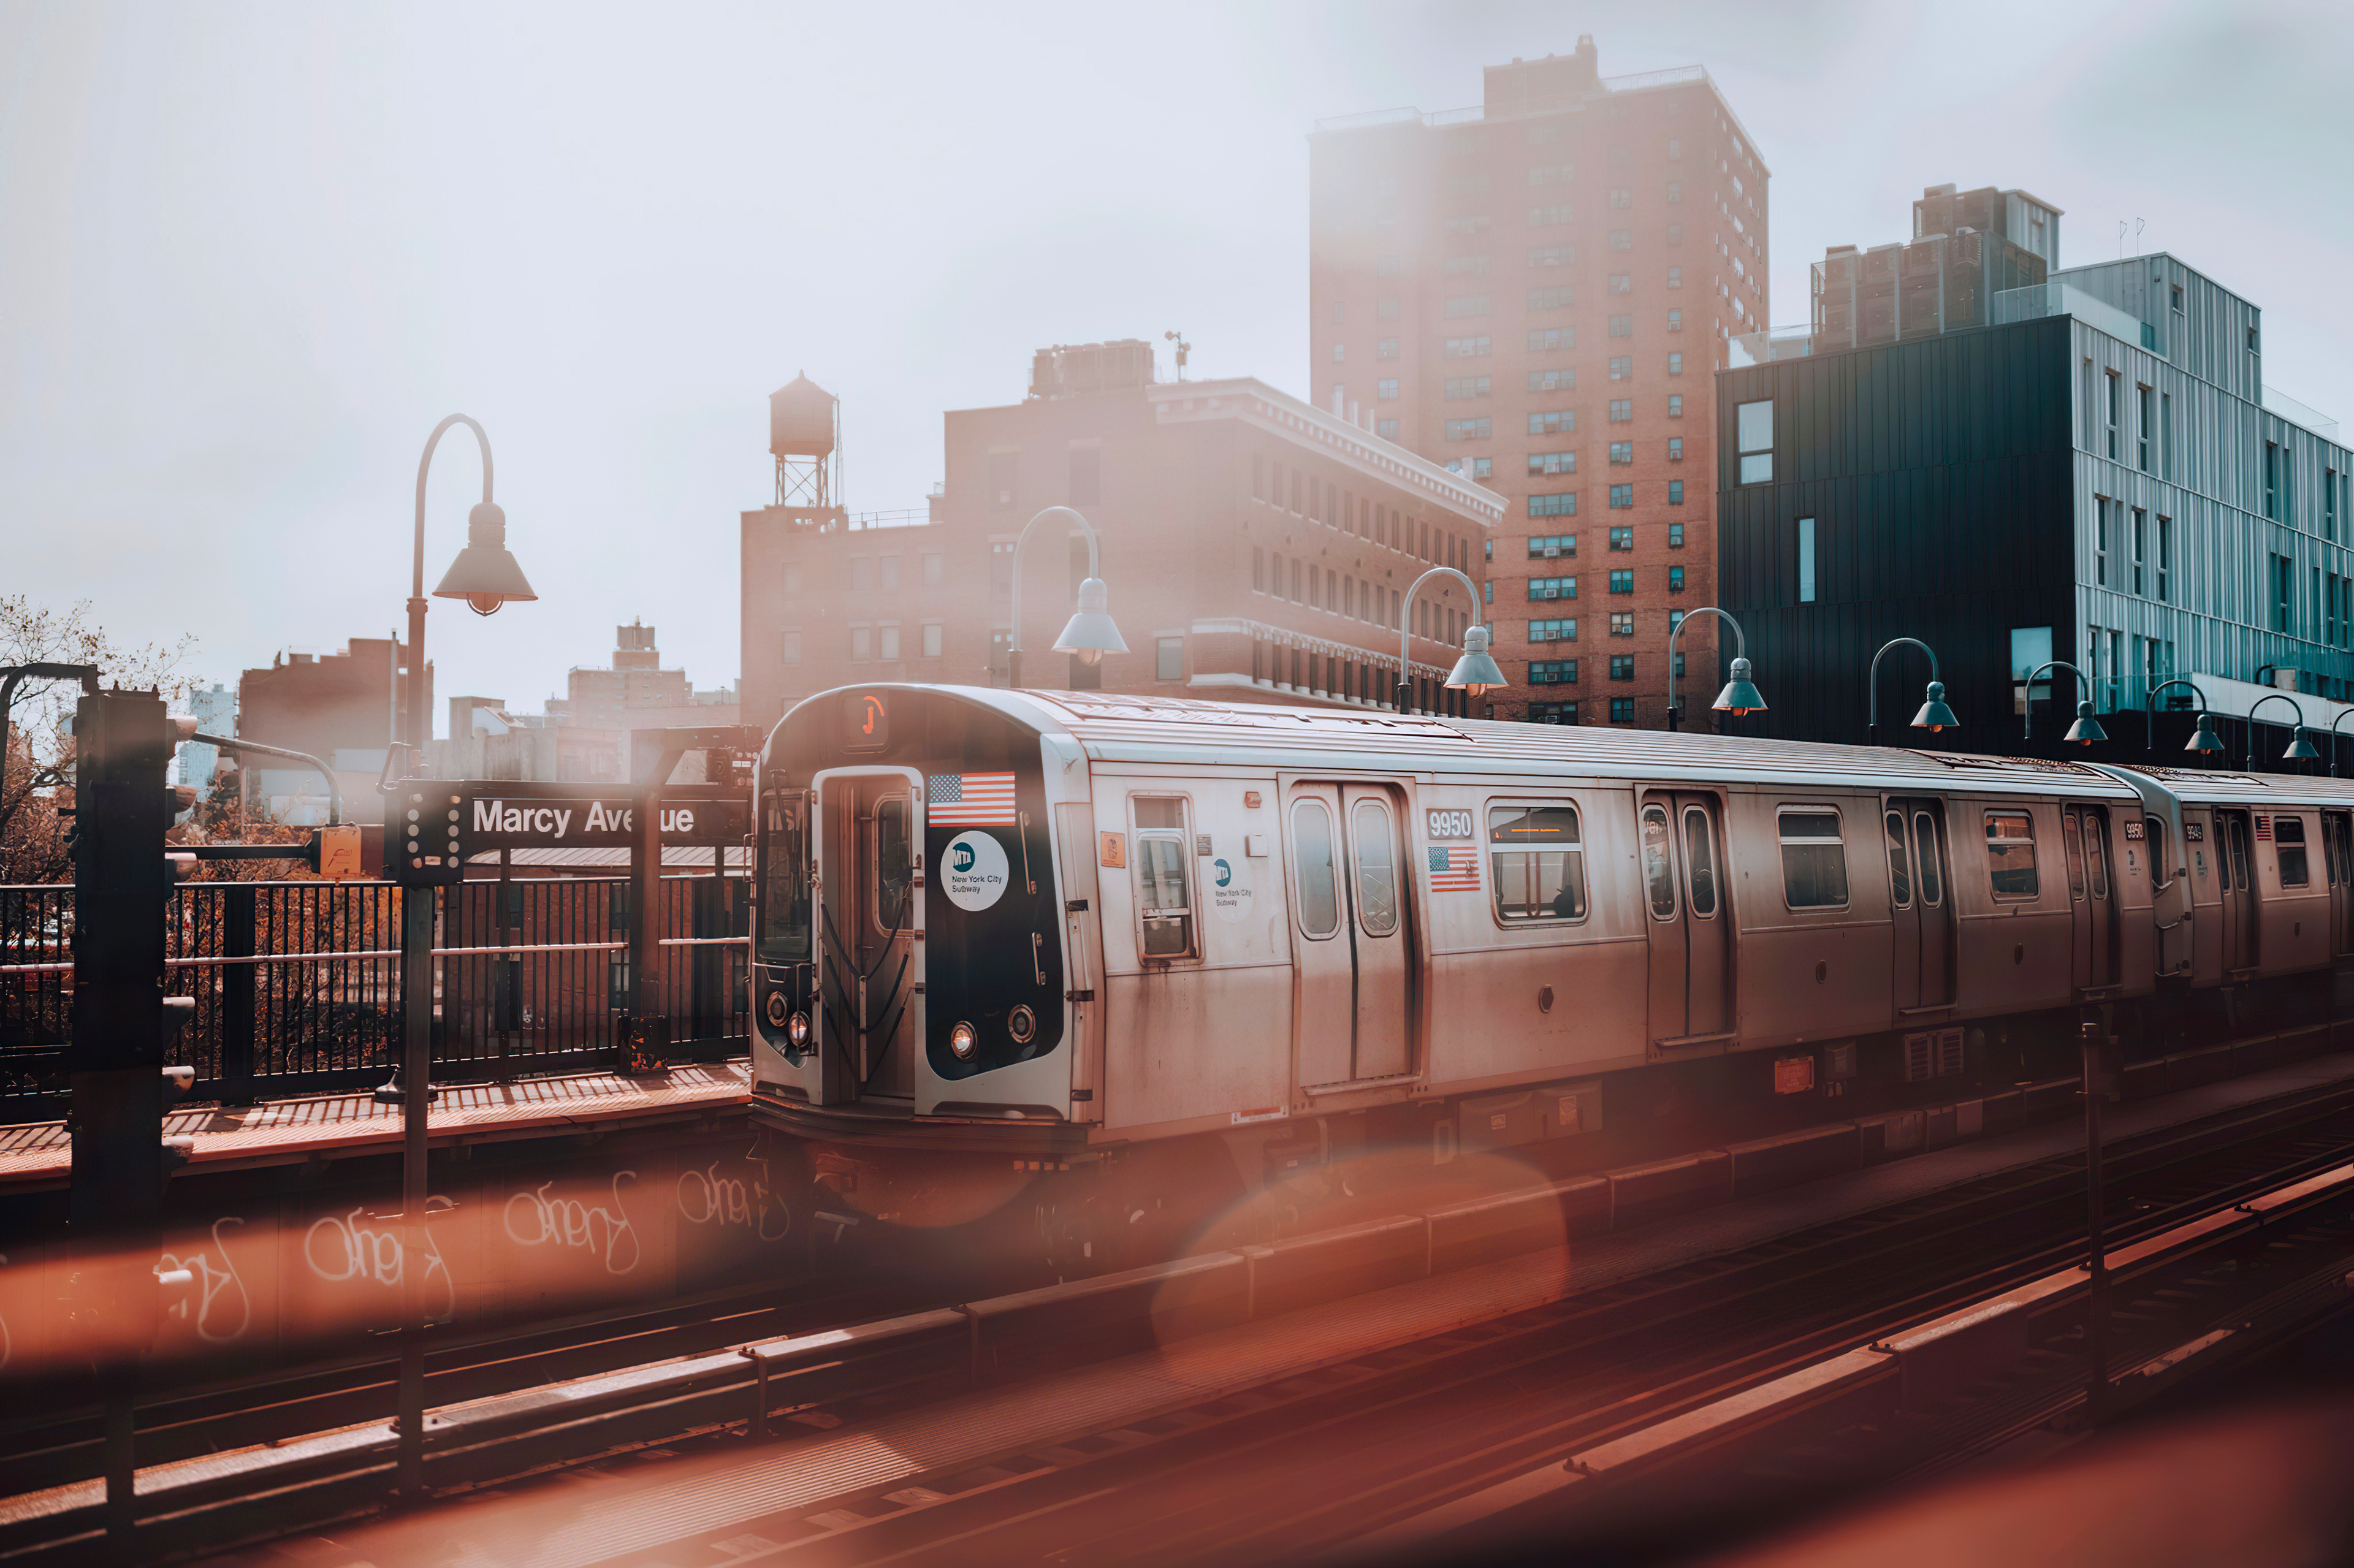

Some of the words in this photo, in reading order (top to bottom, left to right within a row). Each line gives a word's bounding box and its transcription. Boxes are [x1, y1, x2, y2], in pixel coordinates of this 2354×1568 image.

[473, 800, 572, 839] Marcy
[584, 801, 694, 832] Aveue
[1430, 811, 1471, 837] 9950
[952, 849, 972, 866] MTA
[987, 875, 1002, 884] City
